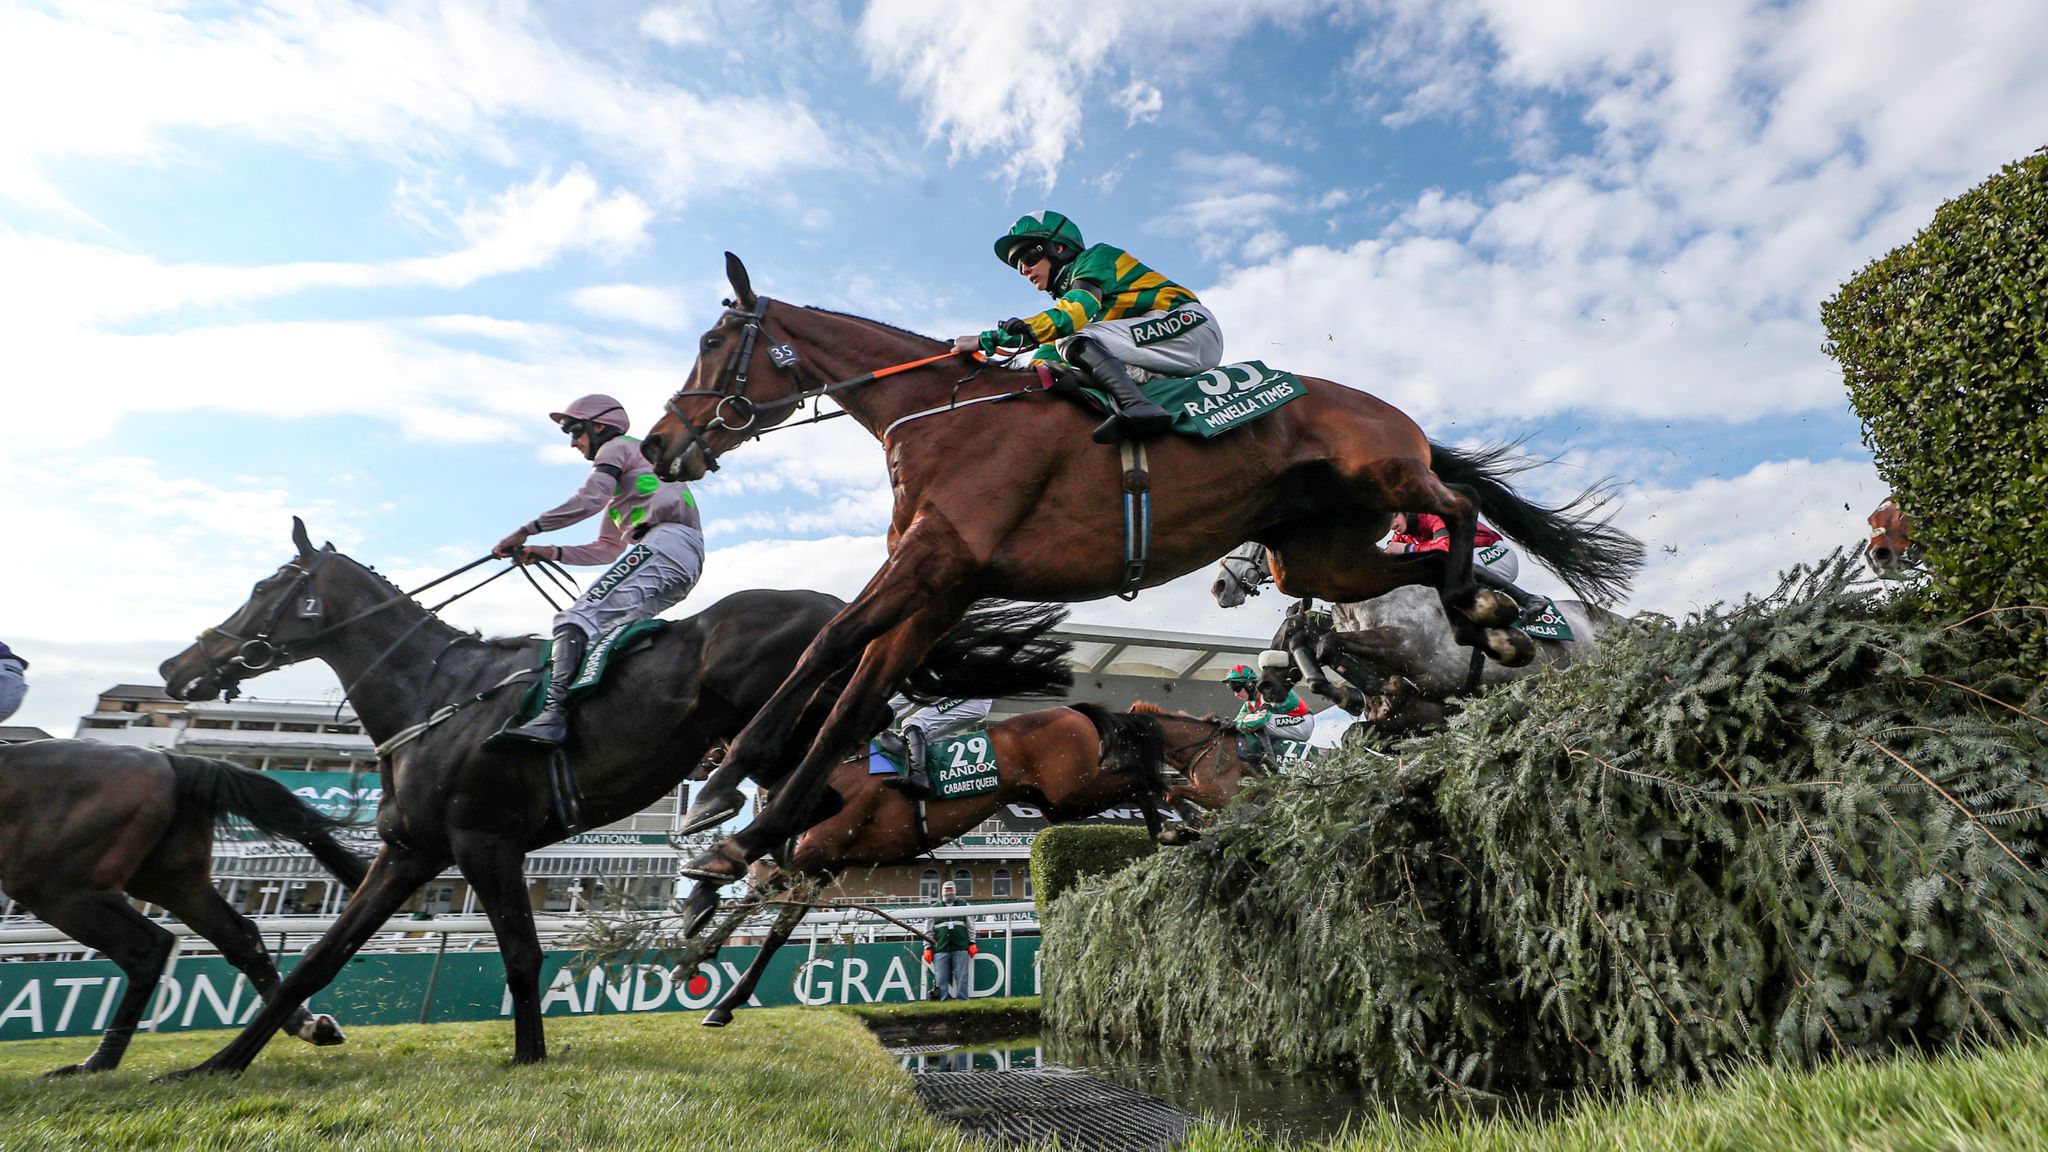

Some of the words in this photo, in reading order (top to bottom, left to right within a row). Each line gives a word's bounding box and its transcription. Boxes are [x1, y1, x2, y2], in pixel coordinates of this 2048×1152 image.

[1135, 310, 1203, 342] RANDOX
[771, 344, 793, 360] 35
[1204, 398, 1261, 428] MINELLA
[1254, 381, 1294, 406] TIMES
[590, 546, 650, 599] RANDOX
[306, 599, 315, 611] 7
[938, 699, 964, 712] RAN
[947, 737, 988, 768] 29
[939, 759, 998, 781] RANDOX
[943, 780, 975, 795] CABARET
[975, 776, 998, 790] QUEEN
[583, 834, 643, 844] NATIONAL
[985, 837, 1023, 845] RANDOX
[982, 912, 1034, 921] NATINAL
[793, 952, 1005, 1006] GRAND
